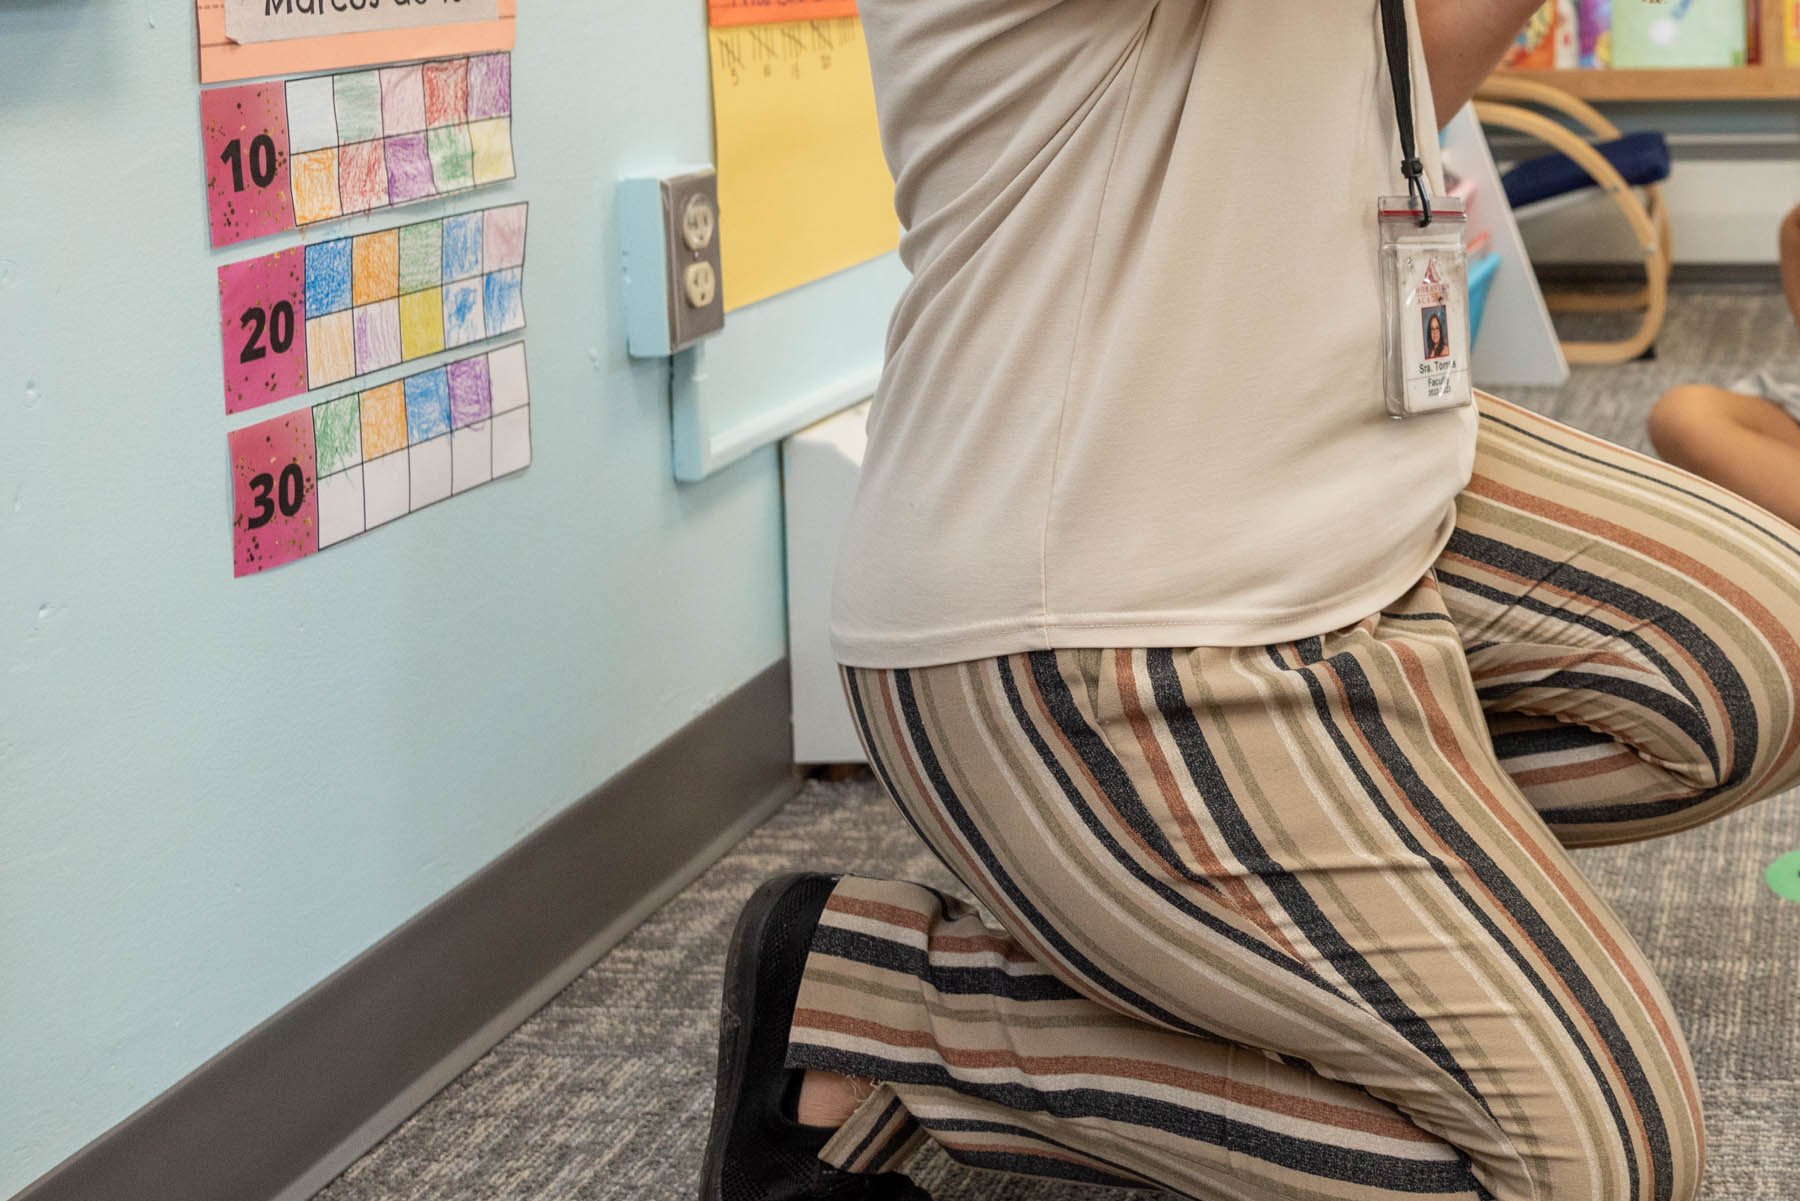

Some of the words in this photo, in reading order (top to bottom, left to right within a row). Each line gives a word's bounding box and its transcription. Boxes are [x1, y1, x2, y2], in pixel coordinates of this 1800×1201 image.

[220, 134, 278, 193] 10
[239, 300, 296, 365] 20
[1427, 375, 1450, 387] Faculy
[1434, 360, 1457, 371] Torrs
[248, 462, 305, 531] 30
